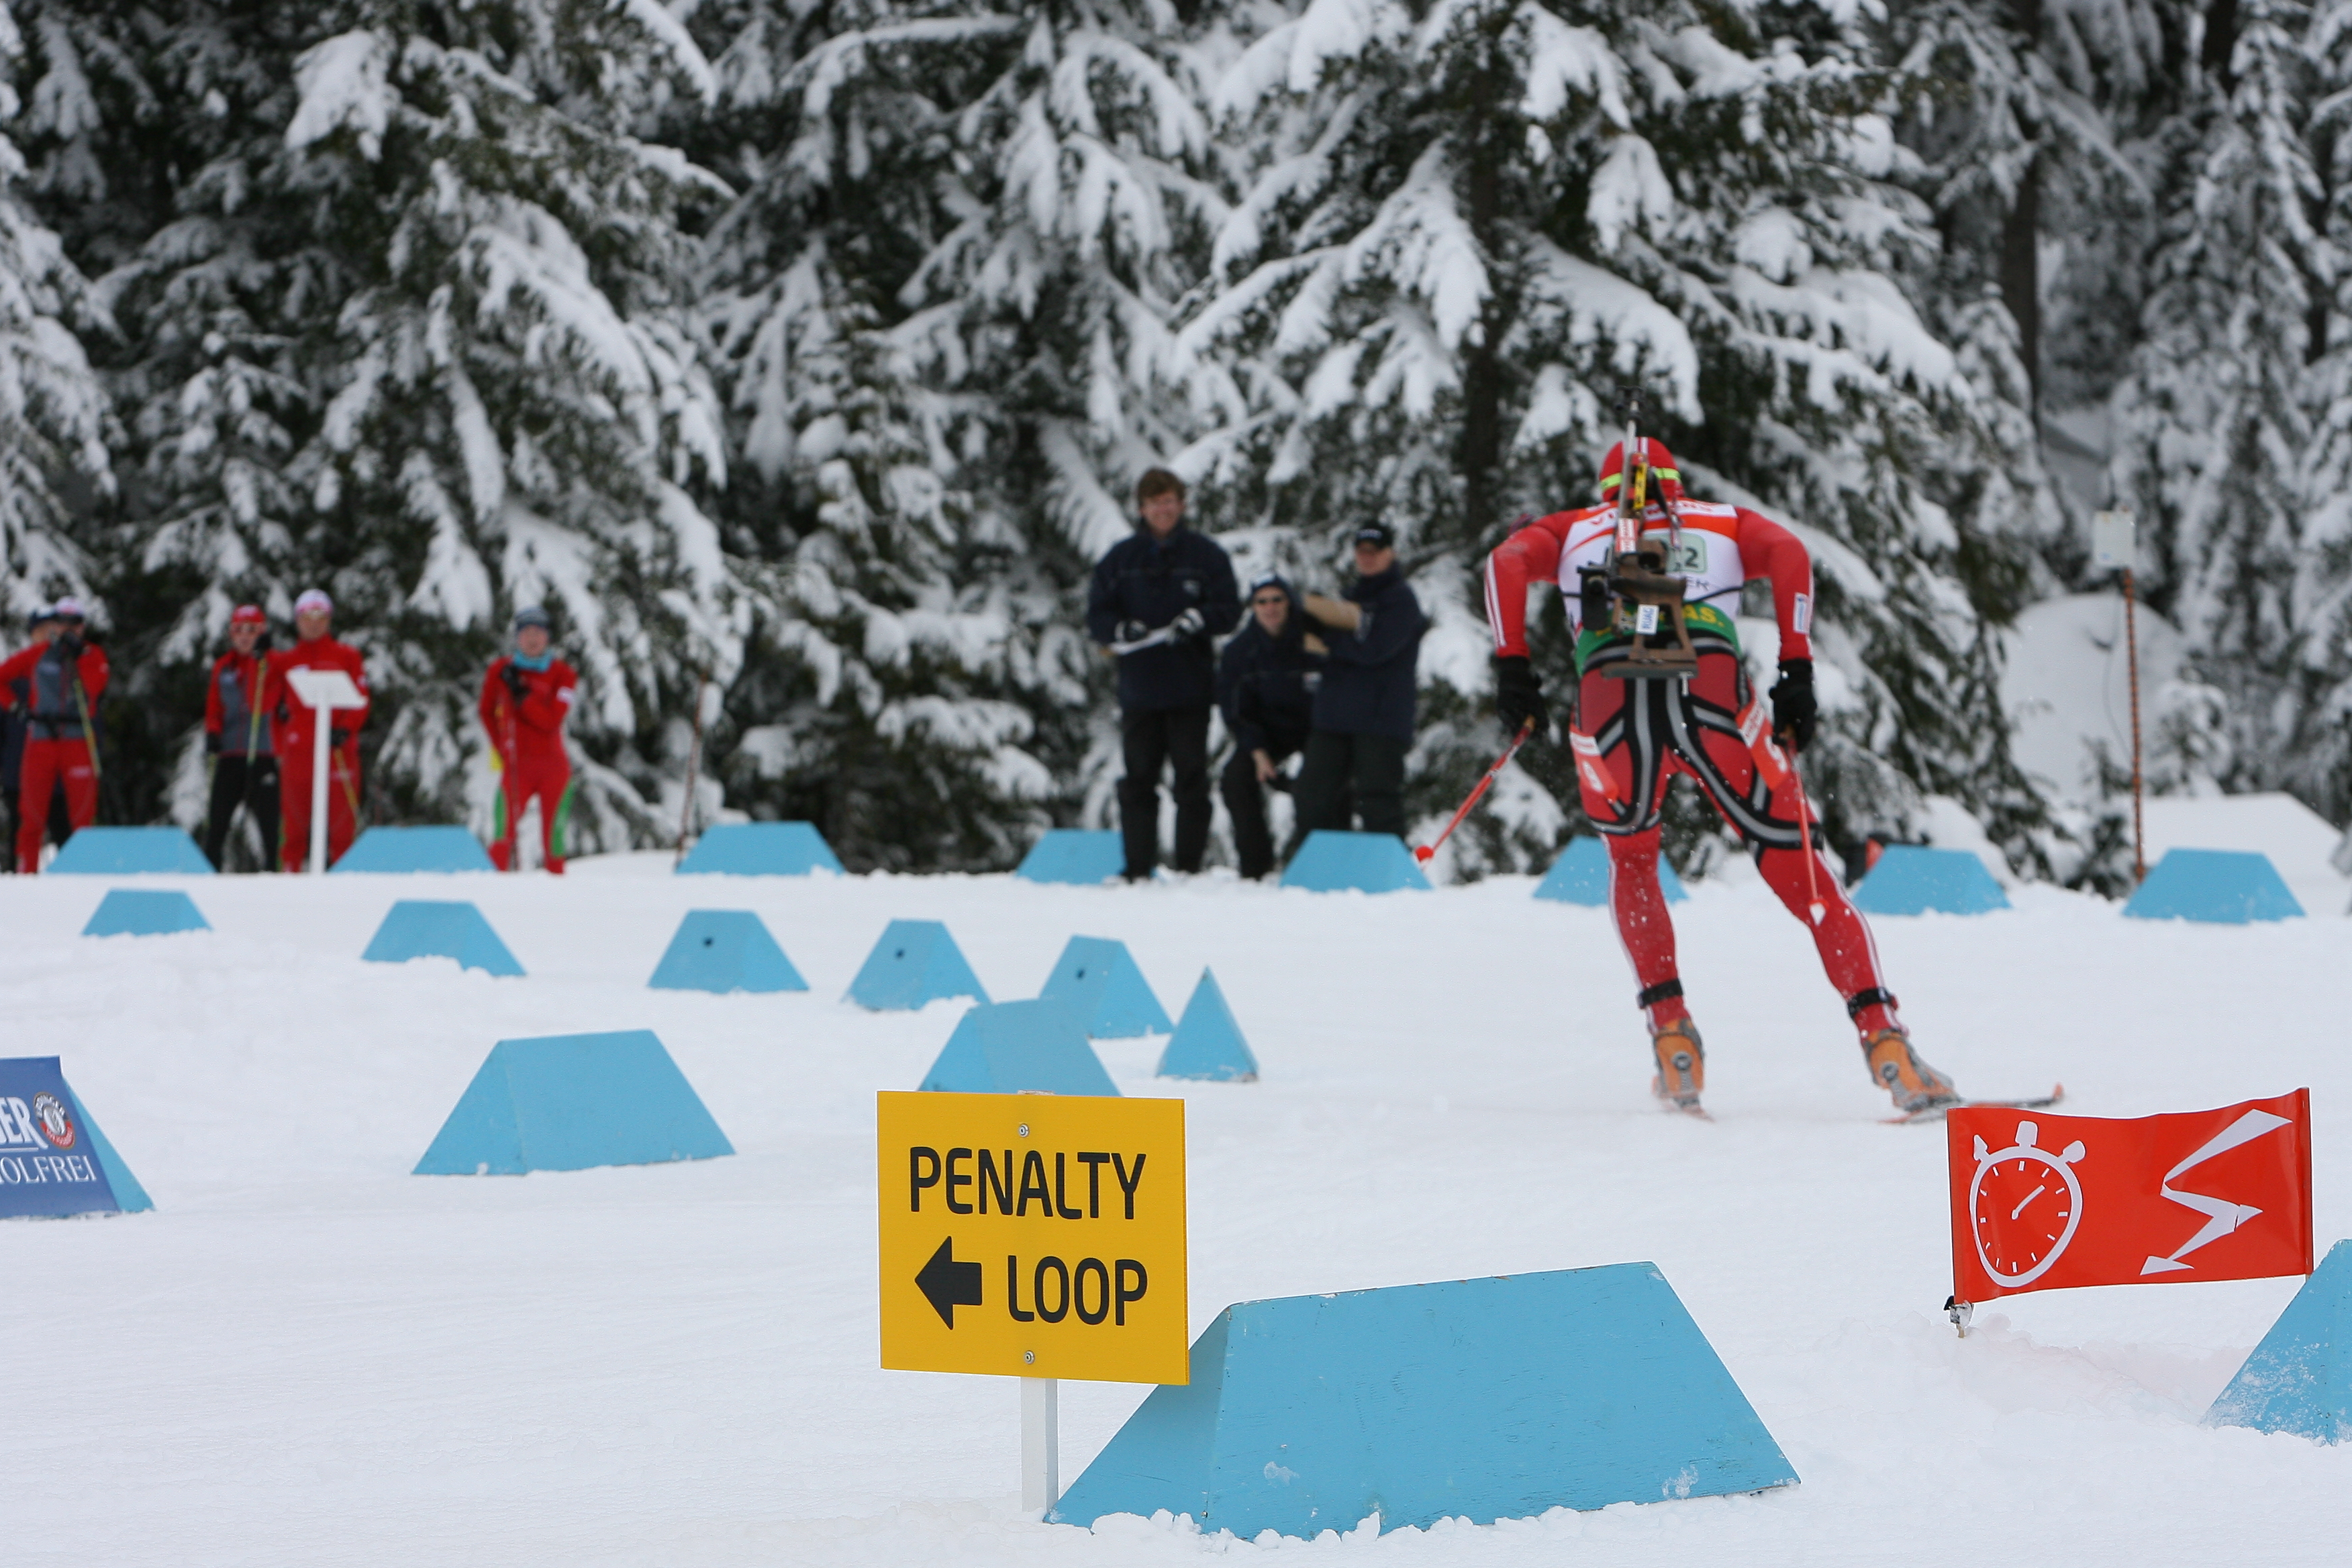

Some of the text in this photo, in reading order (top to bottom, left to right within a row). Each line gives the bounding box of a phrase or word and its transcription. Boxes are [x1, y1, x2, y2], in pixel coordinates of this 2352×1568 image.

[0, 1096, 48, 1150] ER
[0, 1155, 97, 1185] OLFREI
[910, 1146, 1146, 1220] PENALTY
[1008, 1255, 1148, 1326] LOOP
